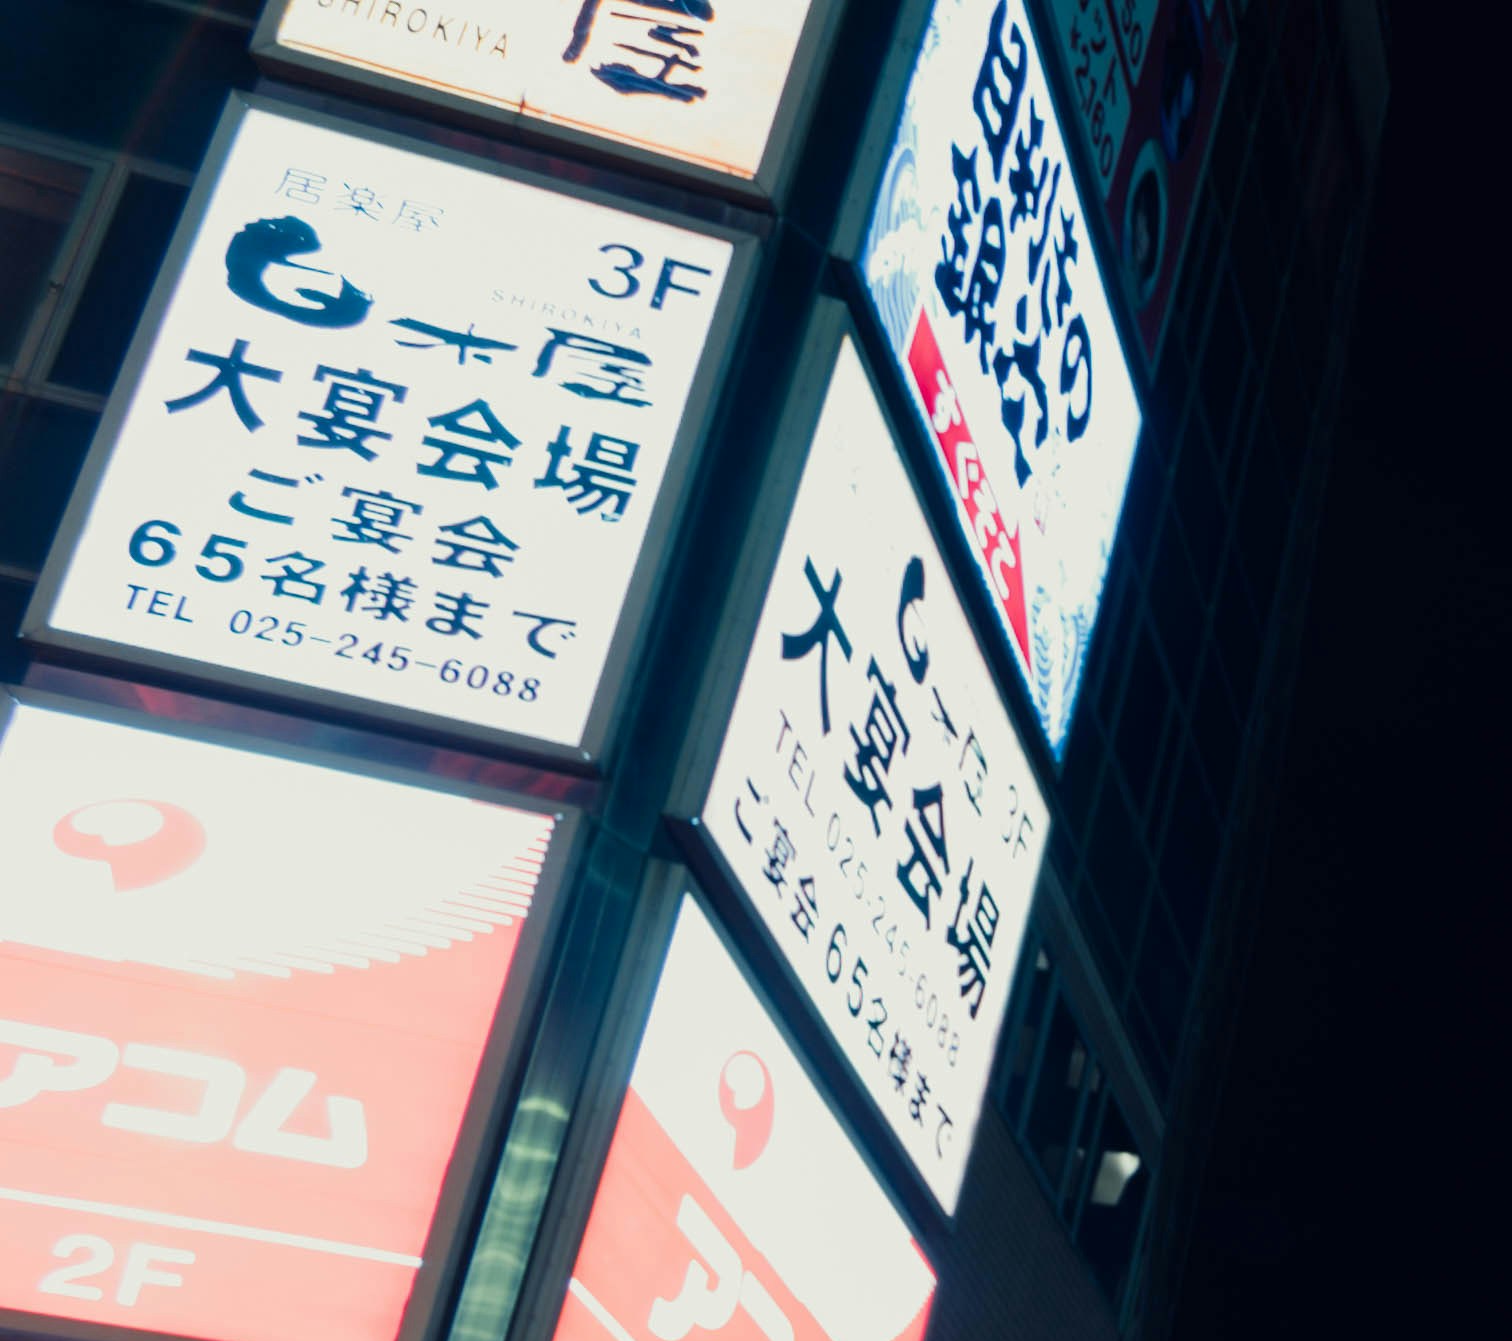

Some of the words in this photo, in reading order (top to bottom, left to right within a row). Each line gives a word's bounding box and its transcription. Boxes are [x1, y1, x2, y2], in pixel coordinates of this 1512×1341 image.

[274, 168, 444, 232] 居楽屋
[491, 288, 643, 340] SHIROKIYA
[587, 243, 712, 311] 3F
[935, 142, 1049, 490] 銀次
[165, 338, 641, 523] 大宴会場
[228, 468, 522, 578] ご宴会
[125, 584, 195, 623] TEL
[229, 609, 541, 702] 025-245-6088
[128, 520, 577, 660] 65名様まで
[776, 709, 817, 818] TEL
[781, 554, 1001, 1019] 大宴会場
[1002, 784, 1035, 859] 3F
[0, 1019, 368, 1169] アコム
[38, 1234, 196, 1307] 2F
